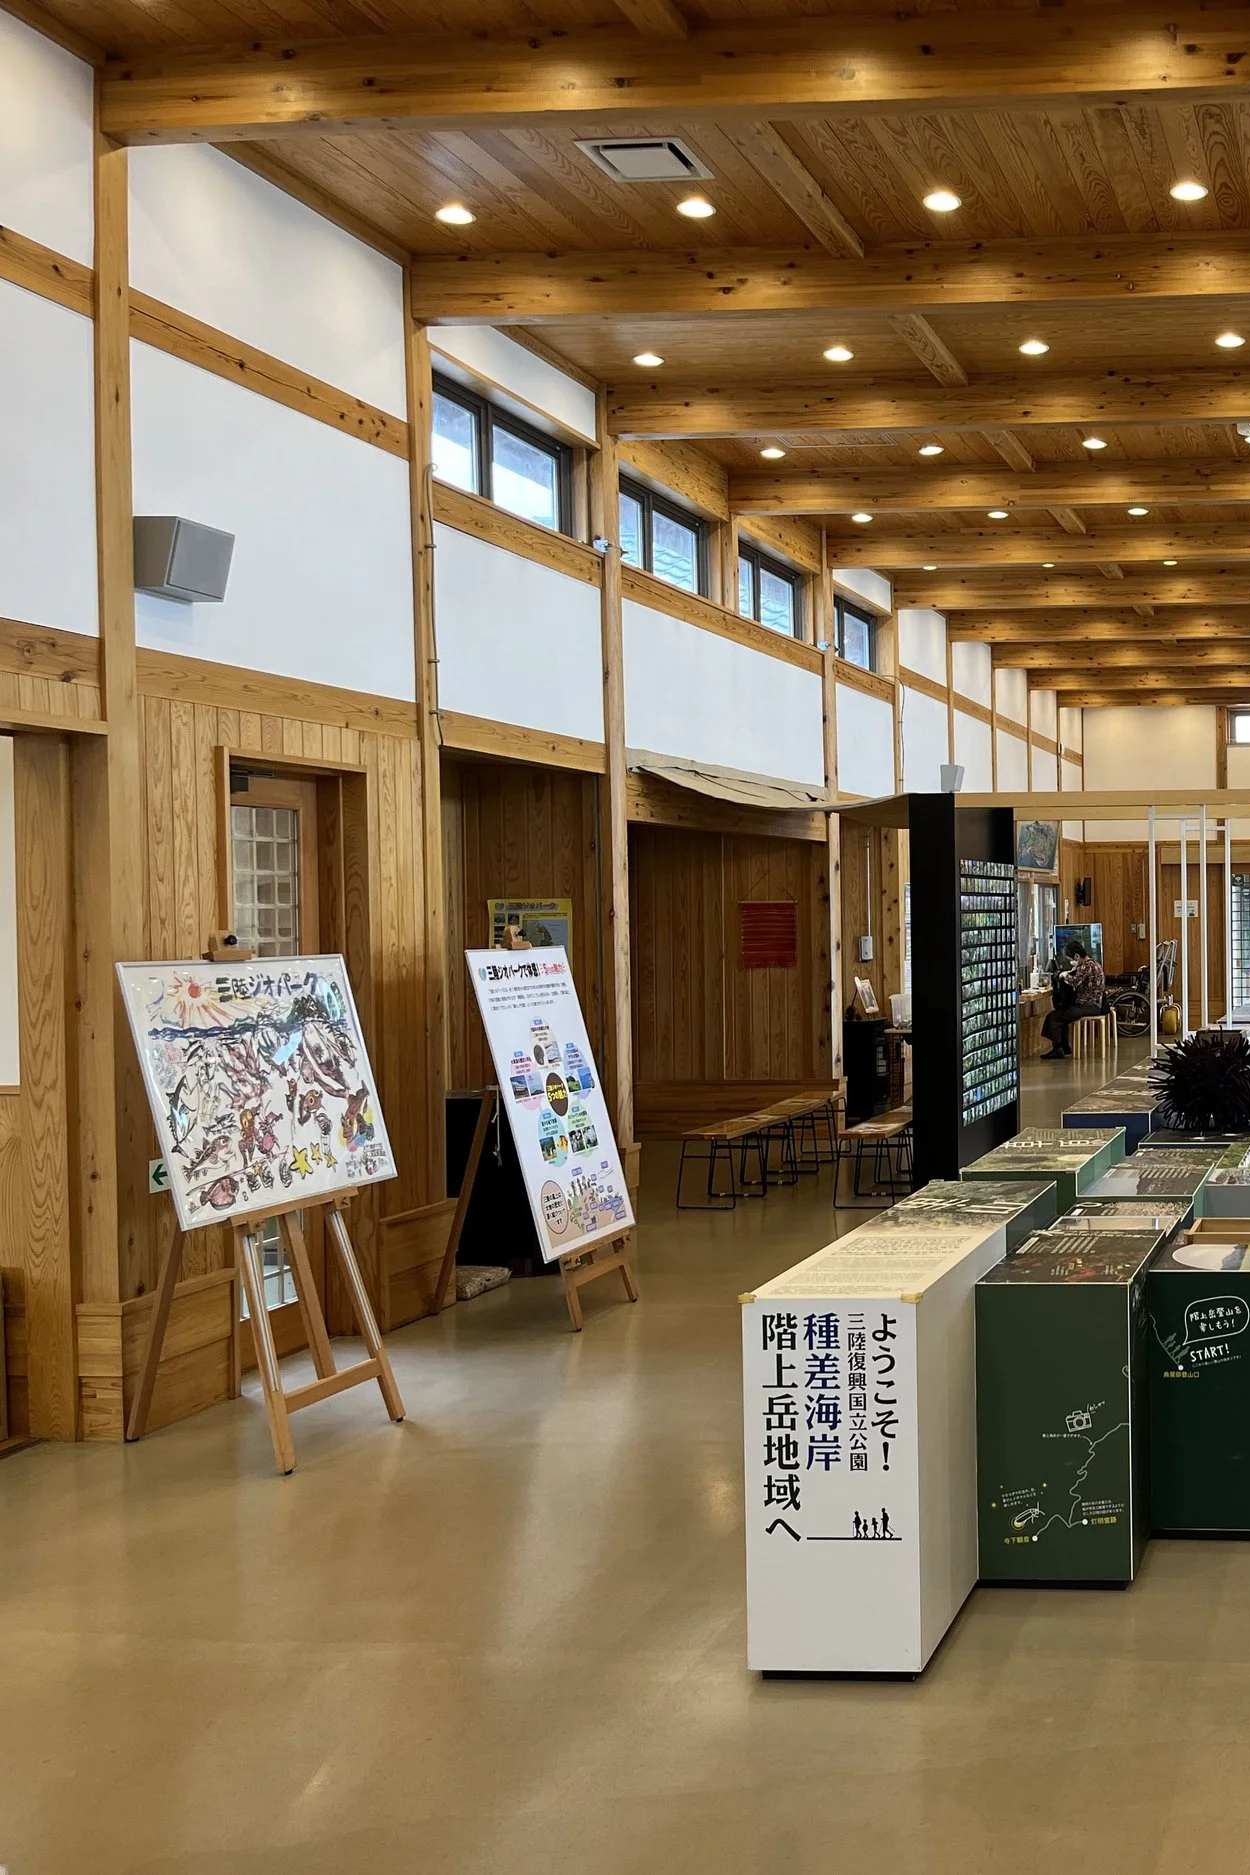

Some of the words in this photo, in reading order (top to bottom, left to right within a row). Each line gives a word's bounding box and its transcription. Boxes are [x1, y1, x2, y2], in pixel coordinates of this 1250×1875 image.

[215, 971, 318, 1003] 三陸ジオパーク
[762, 1312, 802, 1542] 階上岳地域へ
[803, 1312, 842, 1471] 種差海岸
[847, 1312, 868, 1472] 三陸復興国立公園
[871, 1313, 899, 1471] ようこそ！
[1190, 1342, 1230, 1363] START!
